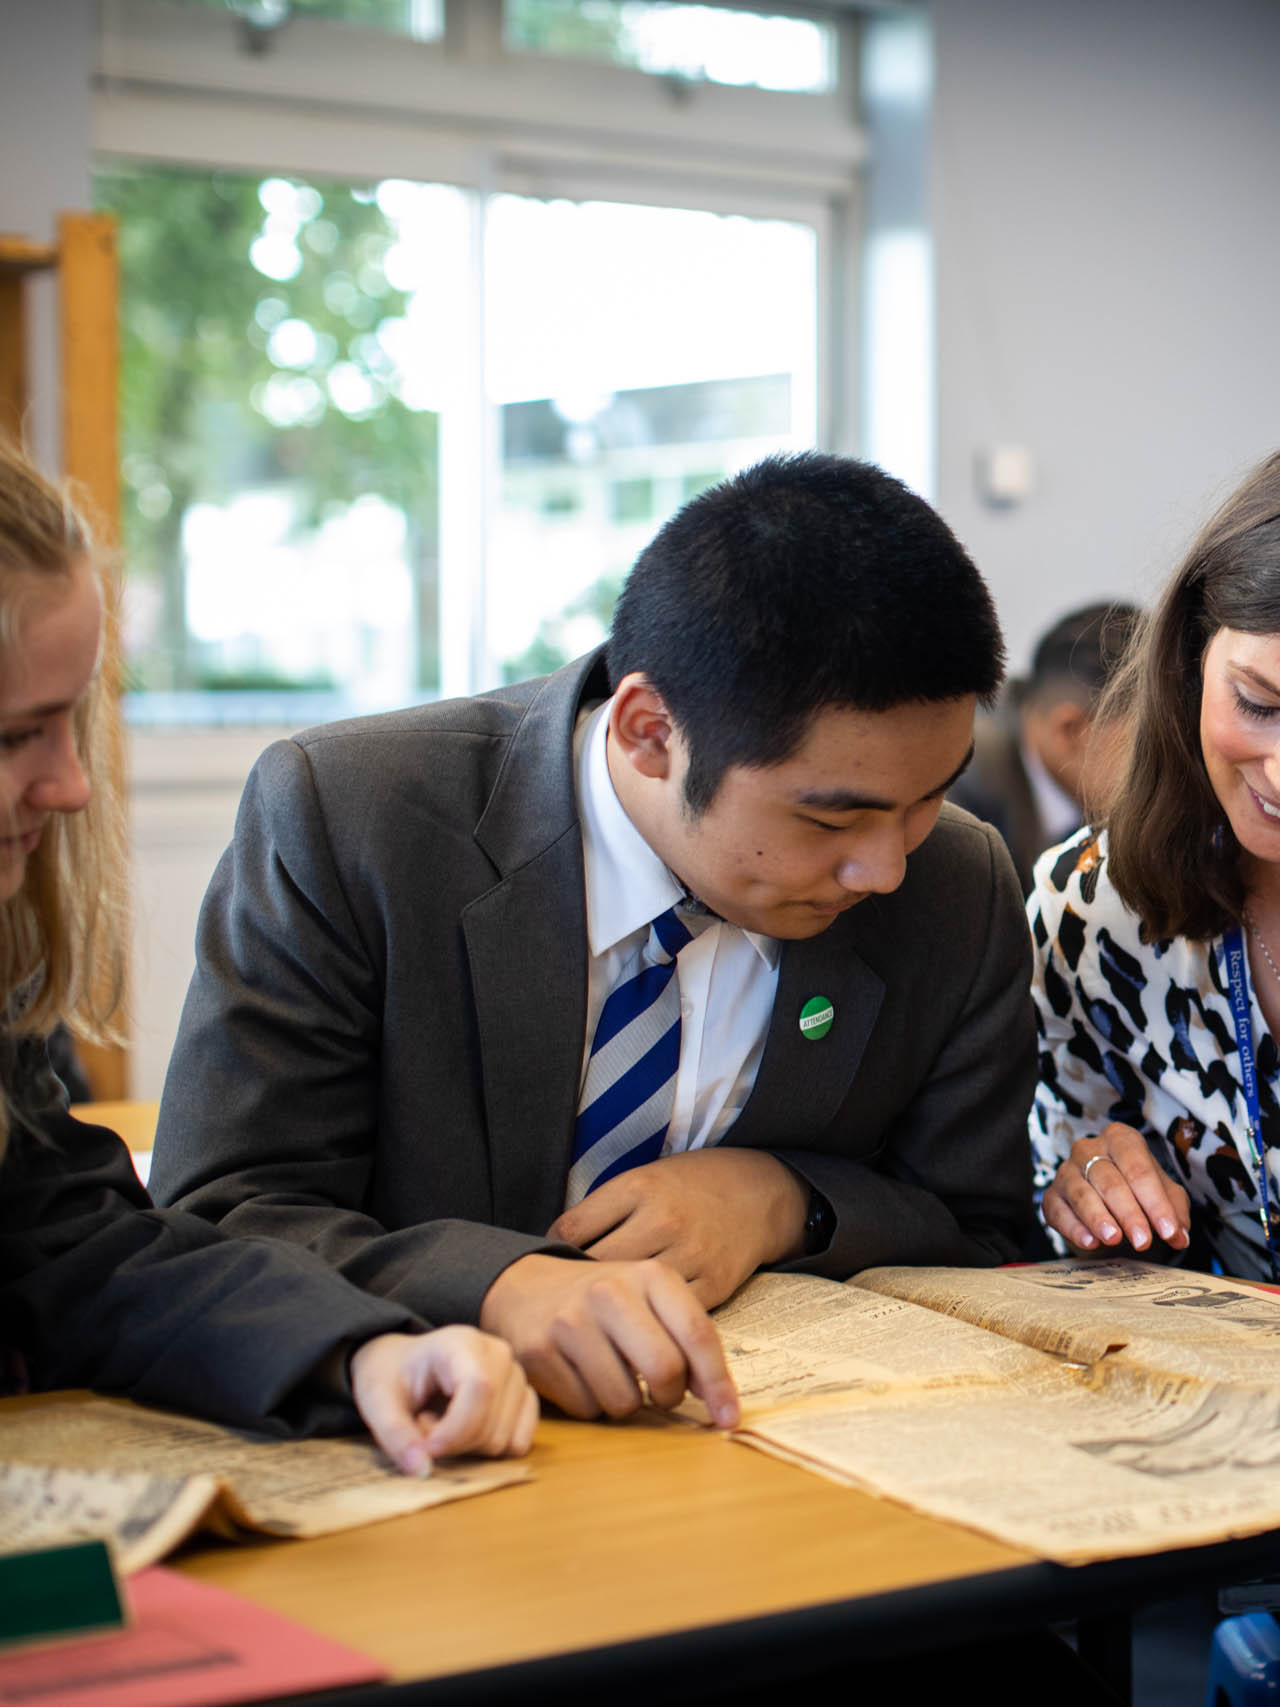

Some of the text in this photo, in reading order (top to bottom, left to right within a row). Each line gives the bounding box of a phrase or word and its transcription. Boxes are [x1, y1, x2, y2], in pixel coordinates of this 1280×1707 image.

[1229, 950, 1246, 1013] Respect
[1238, 1017, 1251, 1041] for
[1241, 1046, 1256, 1098] others
